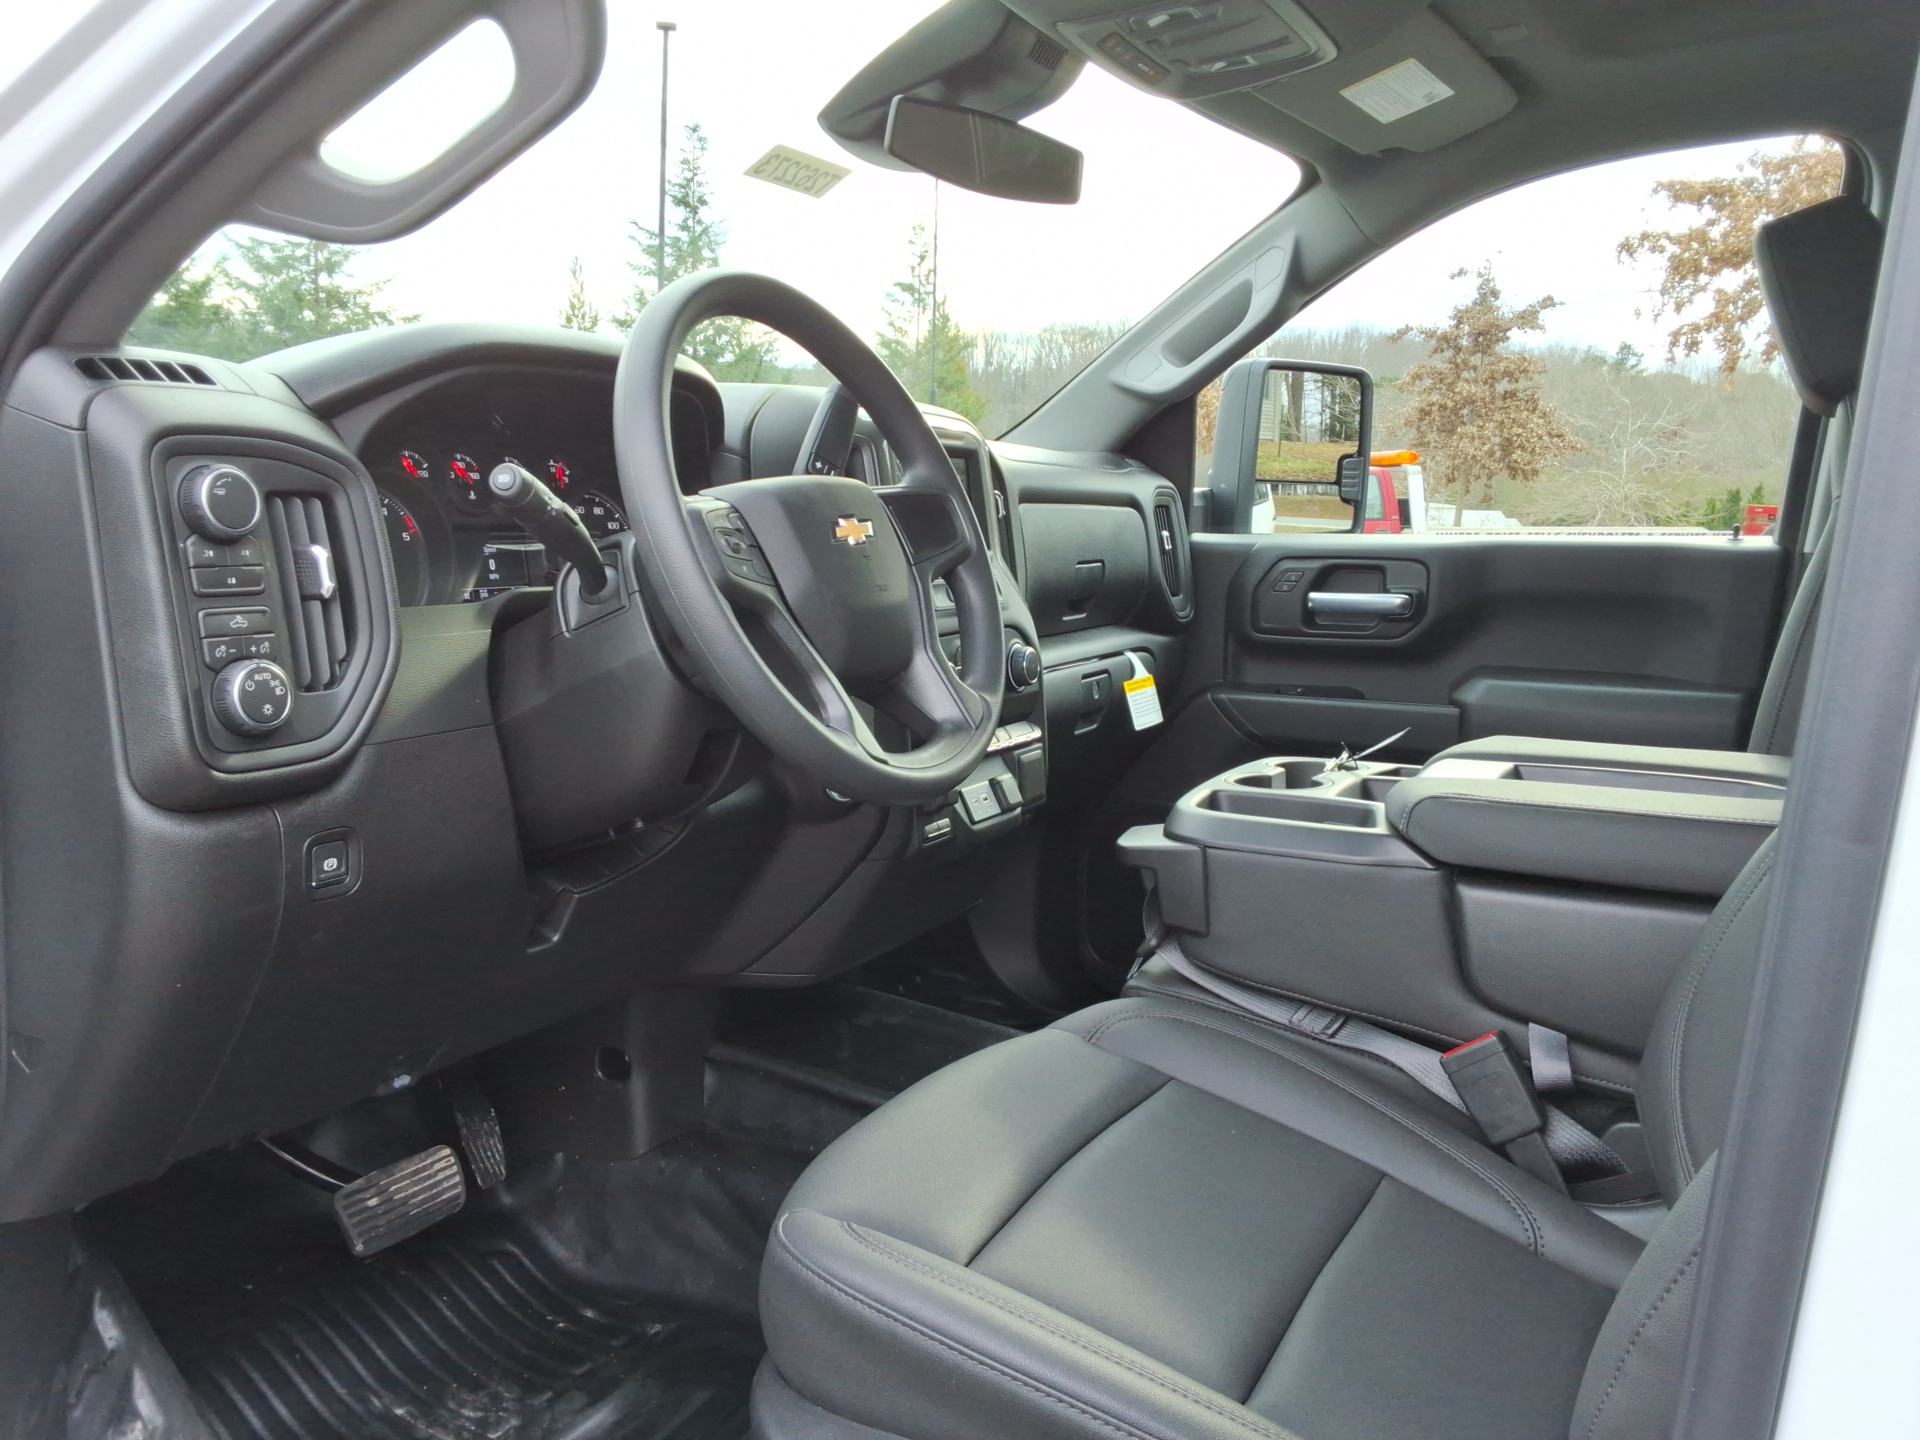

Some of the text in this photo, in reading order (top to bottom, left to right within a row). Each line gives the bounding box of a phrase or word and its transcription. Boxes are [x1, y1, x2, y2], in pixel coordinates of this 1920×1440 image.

[593, 506, 604, 515] 80
[607, 521, 620, 530] 100
[402, 532, 411, 541] 5
[254, 672, 272, 681] AUTO
